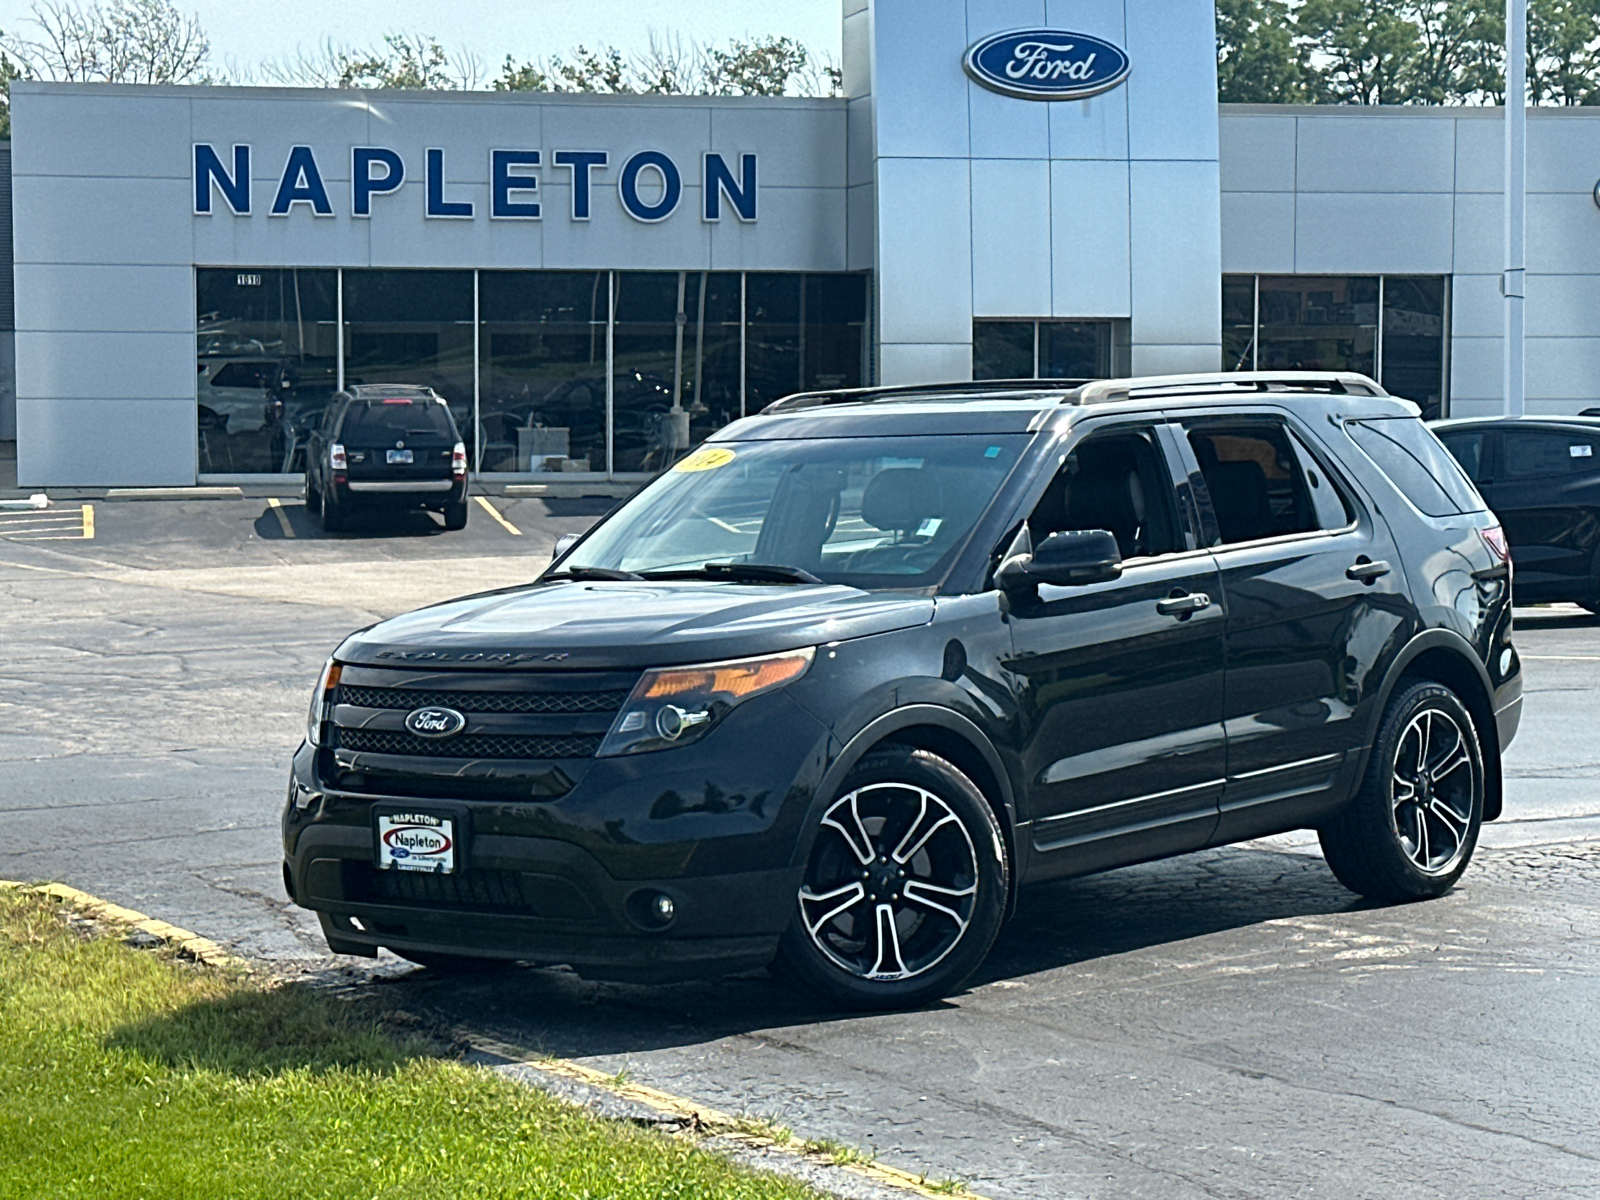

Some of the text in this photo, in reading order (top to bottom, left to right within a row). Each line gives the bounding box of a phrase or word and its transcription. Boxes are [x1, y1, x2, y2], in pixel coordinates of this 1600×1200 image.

[1005, 41, 1097, 80] Ford
[192, 143, 758, 224] NAPLETON
[375, 651, 569, 663] EXPLORER
[414, 711, 448, 732] Ford
[393, 813, 437, 826] NAPLETON
[395, 832, 442, 850] Napleton
